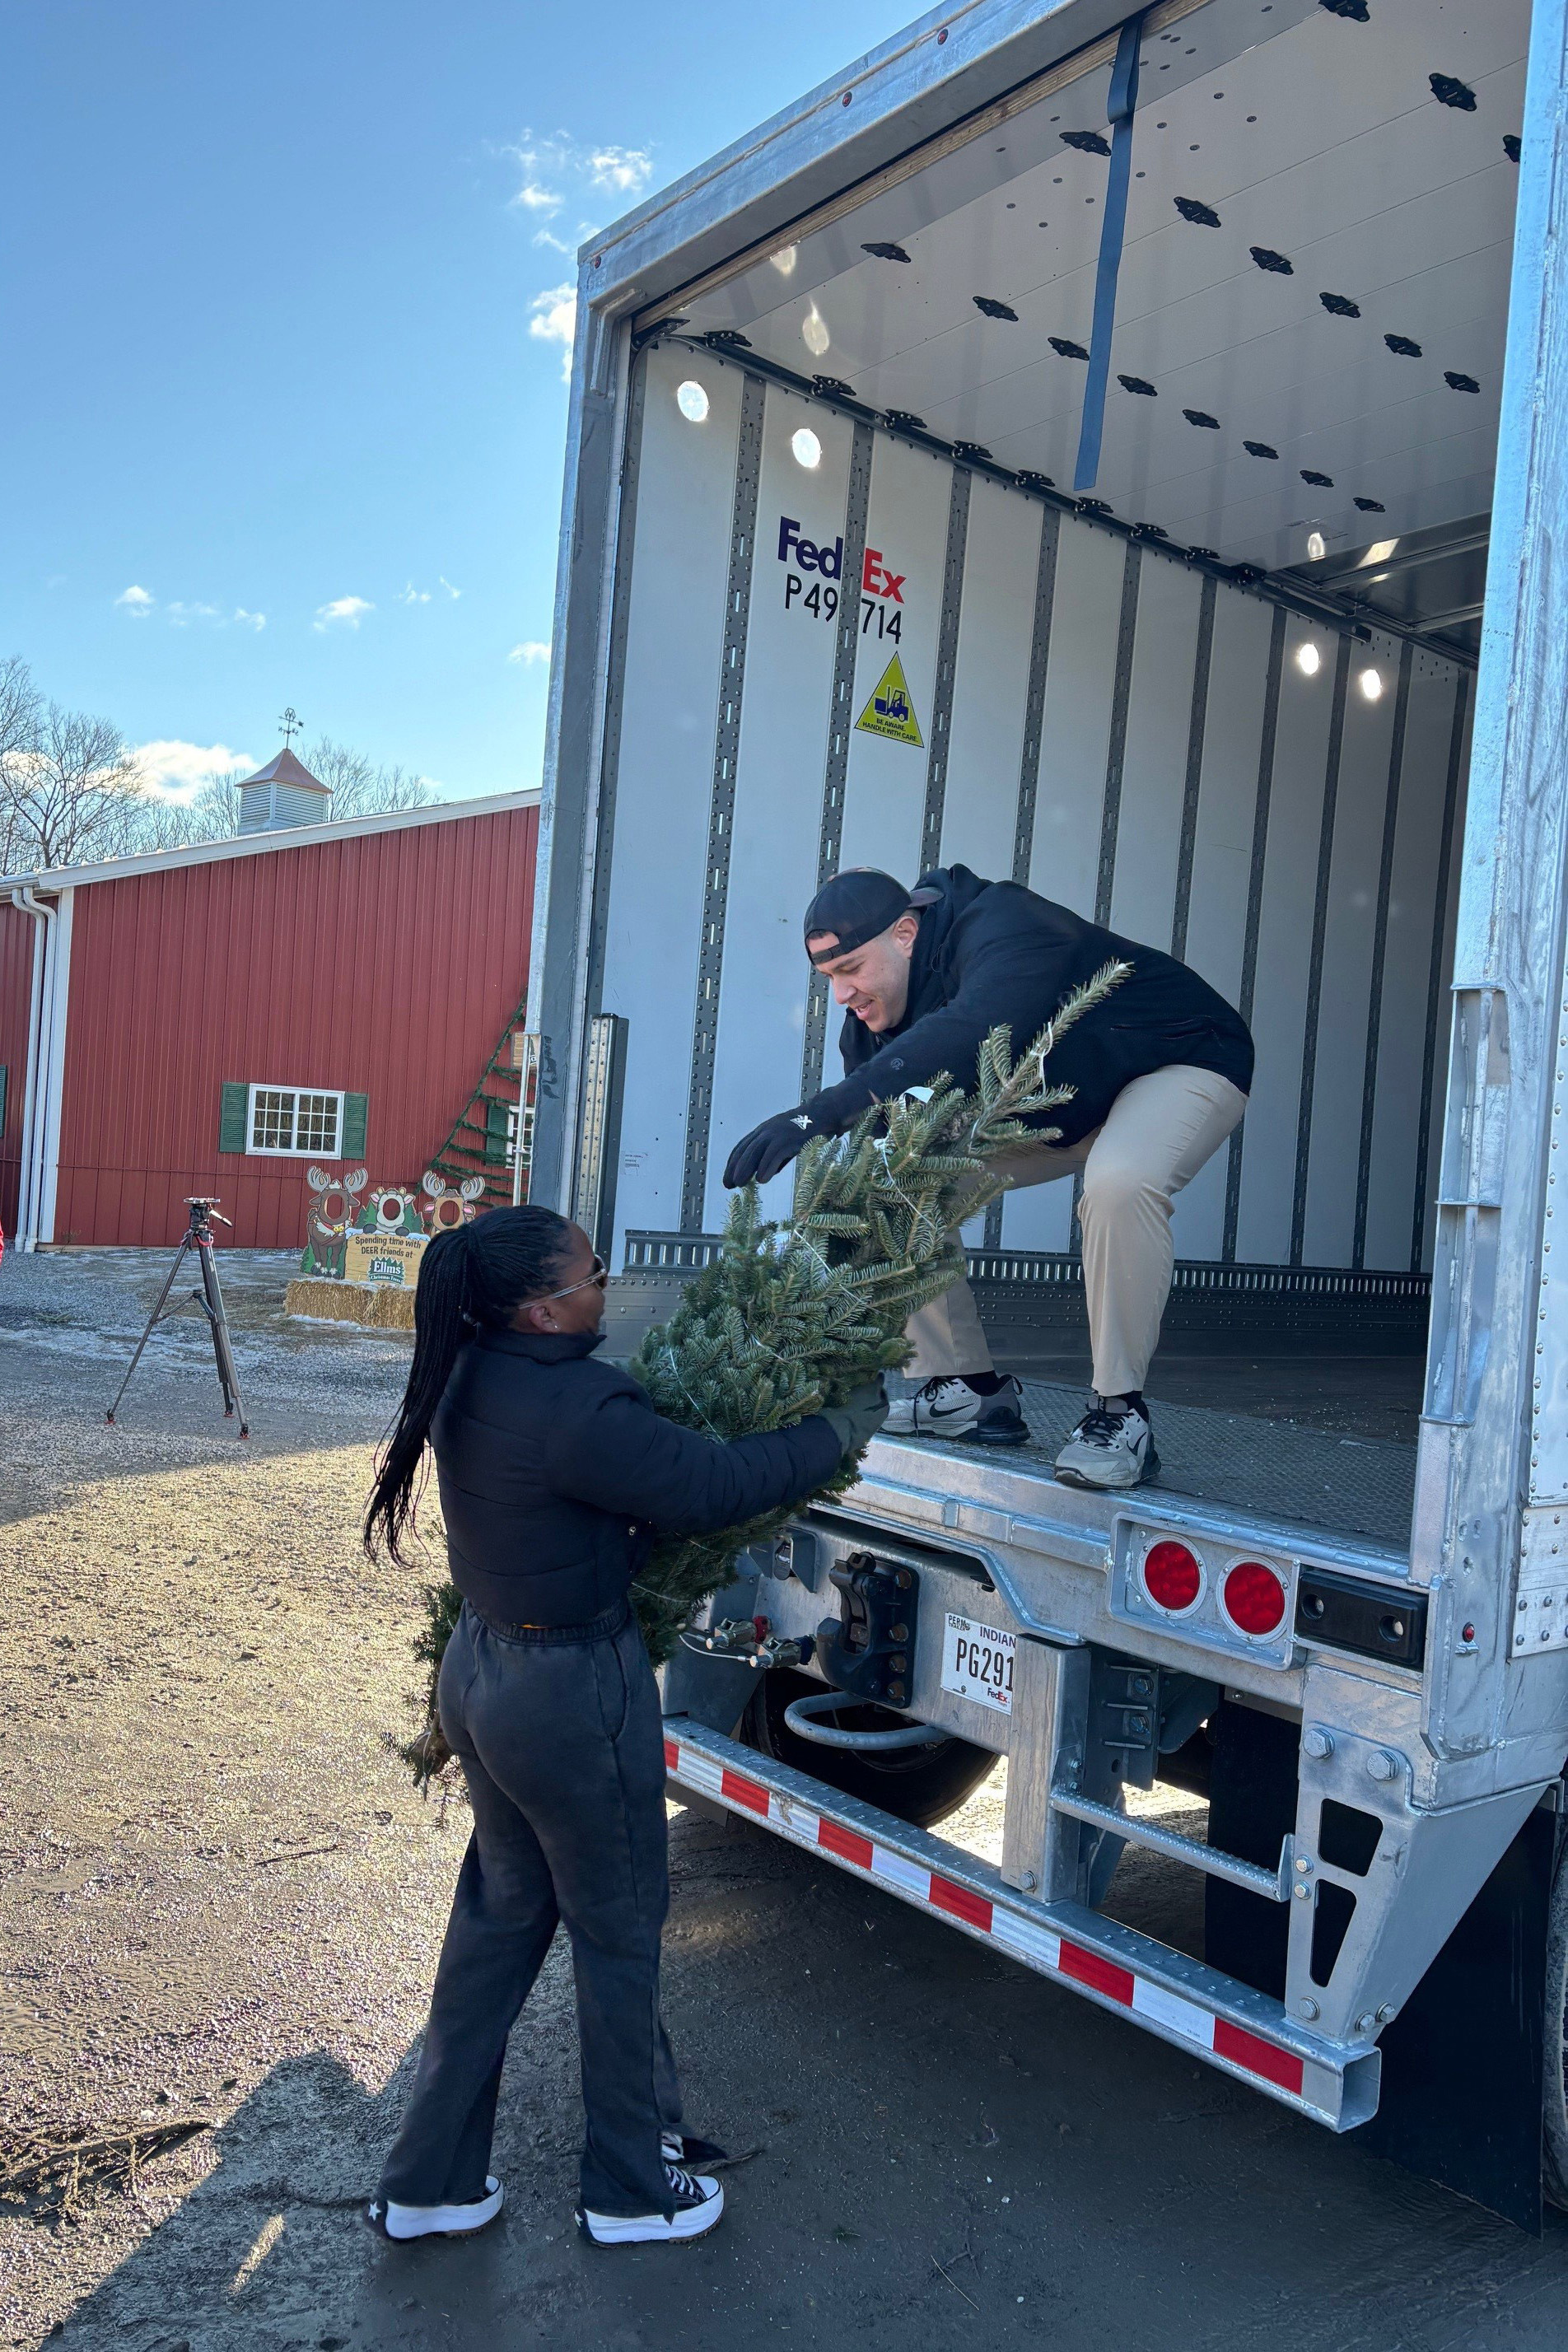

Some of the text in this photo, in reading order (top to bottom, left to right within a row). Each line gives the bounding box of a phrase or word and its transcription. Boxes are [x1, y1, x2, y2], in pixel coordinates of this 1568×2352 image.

[863, 721, 885, 732] HANDLE
[885, 721, 905, 730] AWARE
[356, 1235, 421, 1248] Spending time with
[380, 1247, 404, 1257] friends
[374, 1261, 401, 1274] Ellms
[949, 1615, 965, 1626] PERM
[987, 1687, 1007, 1702] FedEx
